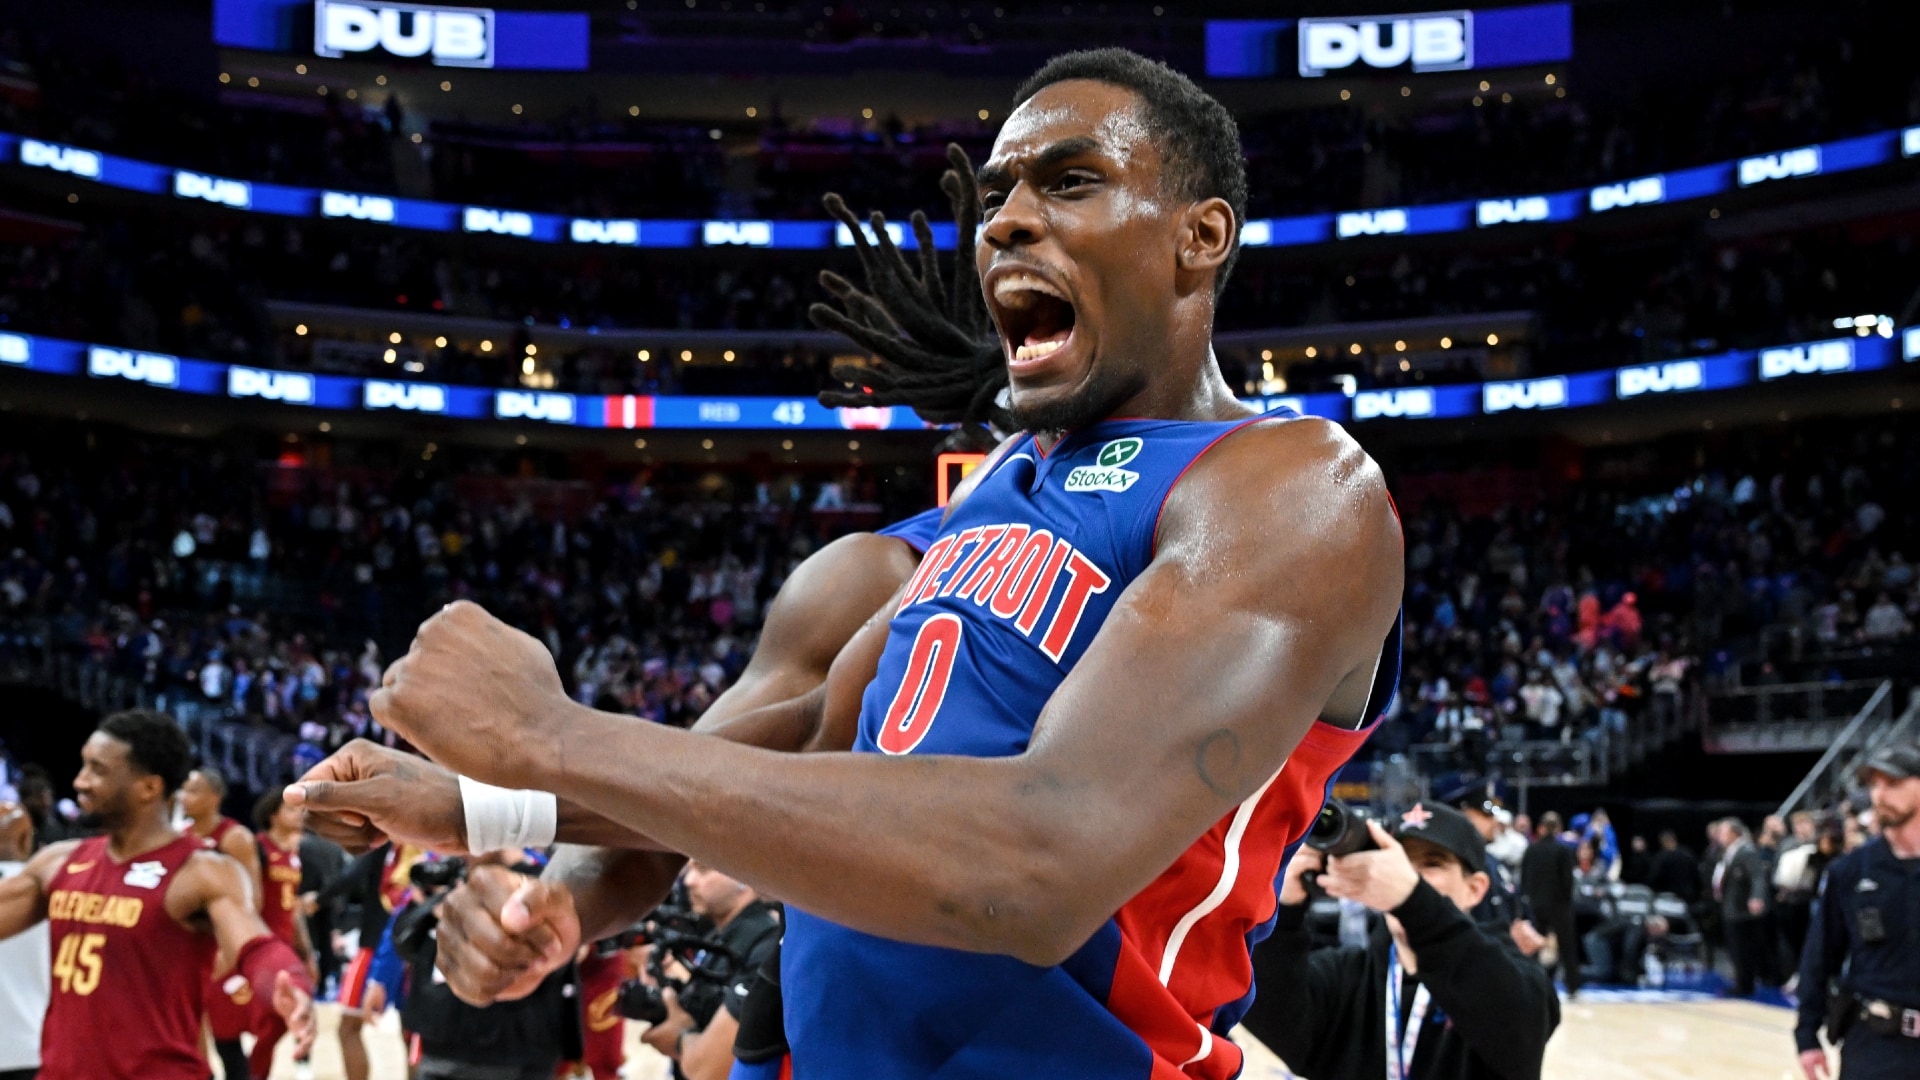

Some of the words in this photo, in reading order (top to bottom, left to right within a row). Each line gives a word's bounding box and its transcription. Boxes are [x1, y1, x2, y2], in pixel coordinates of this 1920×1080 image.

[325, 3, 487, 58] DUB
[1305, 16, 1465, 68] DUB
[22, 141, 98, 175] DUB
[1741, 150, 1818, 183] DUB
[177, 173, 248, 205] DUB
[1592, 179, 1662, 209] DUB
[324, 193, 393, 221] DUB
[466, 208, 532, 235] DUB
[1339, 210, 1406, 236] DUB
[1479, 198, 1548, 225] DUB
[572, 221, 637, 243] DUB
[705, 222, 771, 244] DUB
[92, 349, 175, 383] DUB
[1763, 342, 1851, 376] DUB
[231, 369, 311, 401] DUB
[1620, 362, 1701, 395] DUB
[367, 382, 444, 411] DUB
[498, 392, 572, 420] DUB
[1354, 390, 1432, 417] DUB
[1486, 380, 1564, 410] DUB
[773, 402, 805, 423] 43
[894, 523, 1111, 664] DETROIT
[877, 613, 962, 755] 0
[49, 889, 144, 929] CLEVELAND
[53, 932, 107, 996] 45
